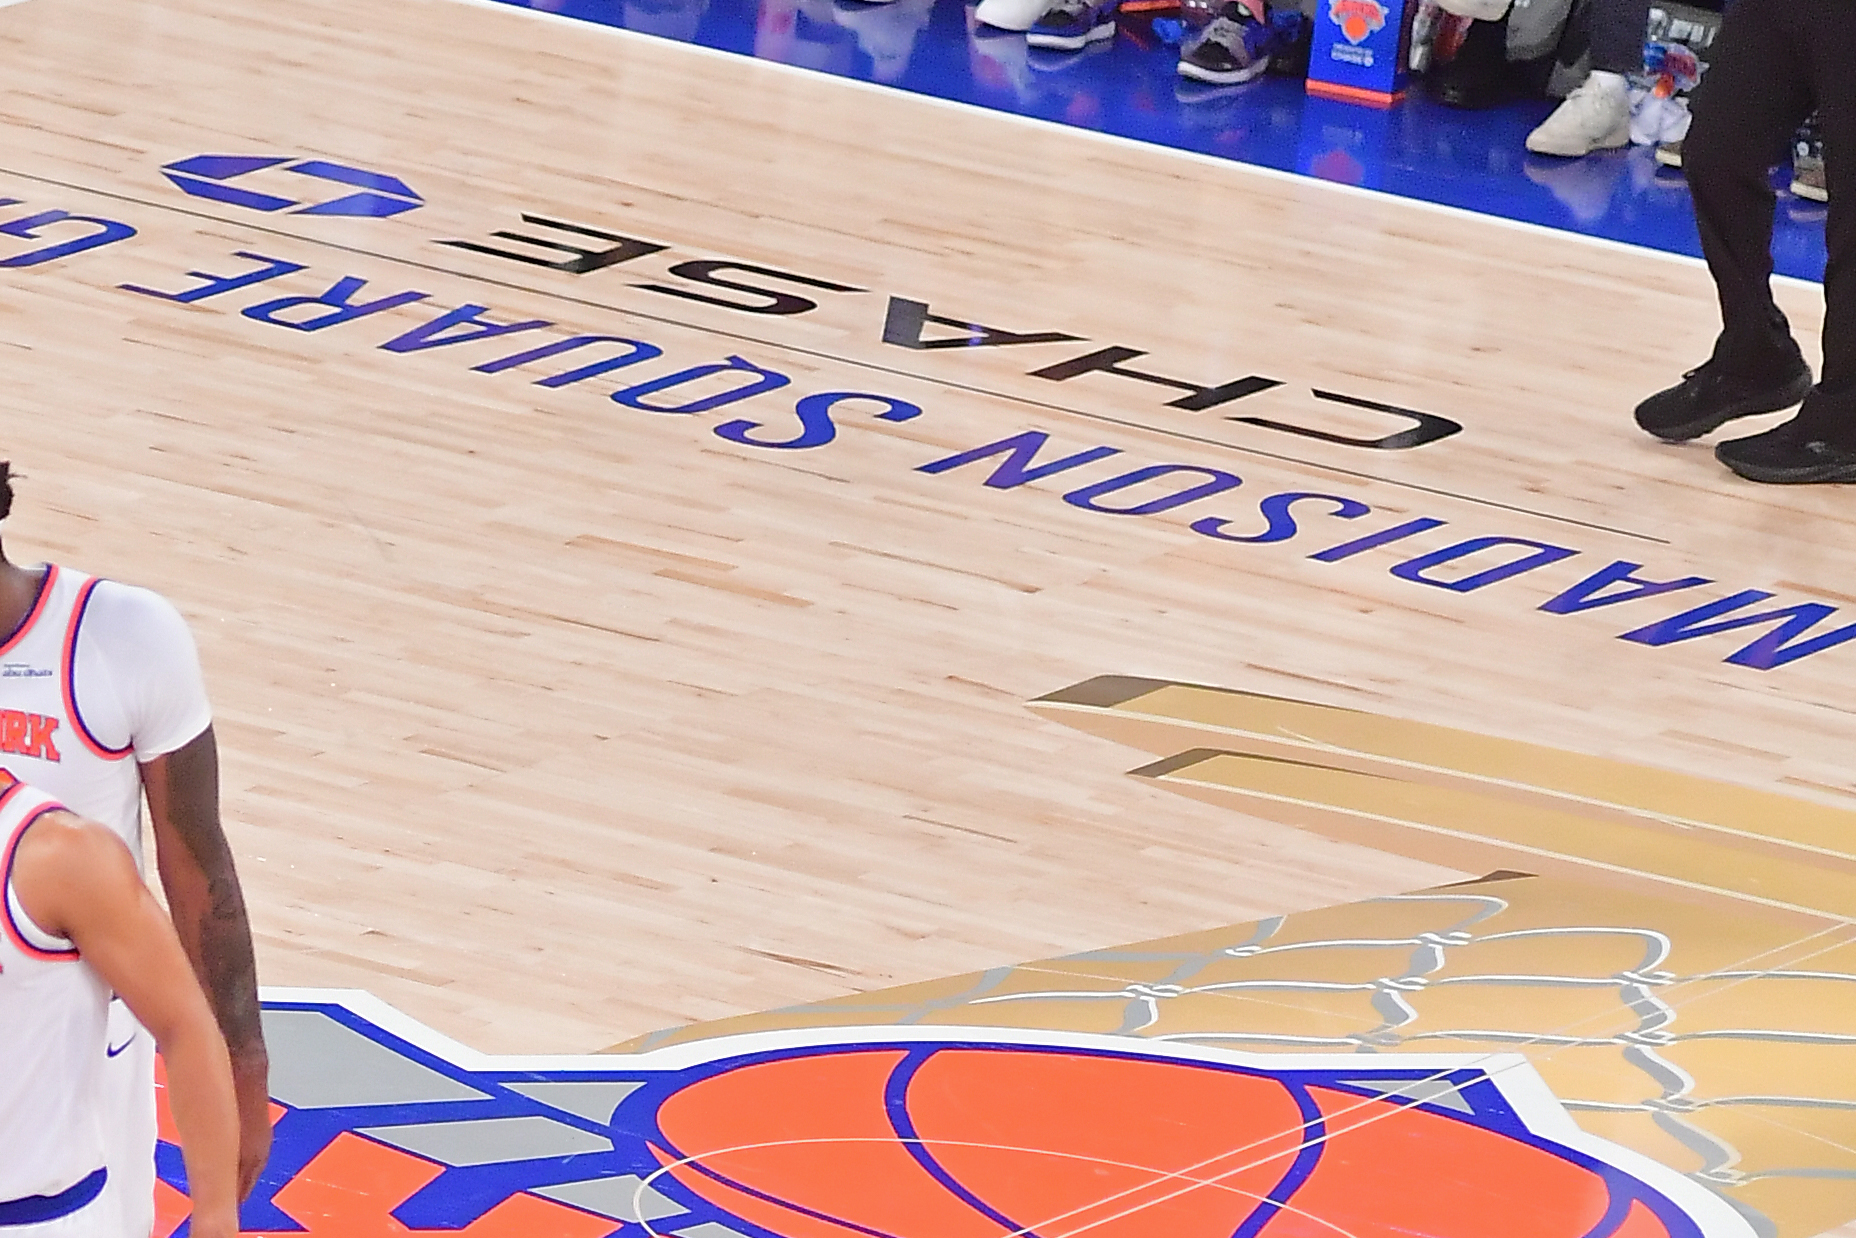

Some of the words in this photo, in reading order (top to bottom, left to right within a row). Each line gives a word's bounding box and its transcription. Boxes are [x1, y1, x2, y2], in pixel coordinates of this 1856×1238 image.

[116, 250, 923, 449] SQUARE
[431, 211, 1464, 449] CHASE
[914, 430, 1856, 670] MADISON
